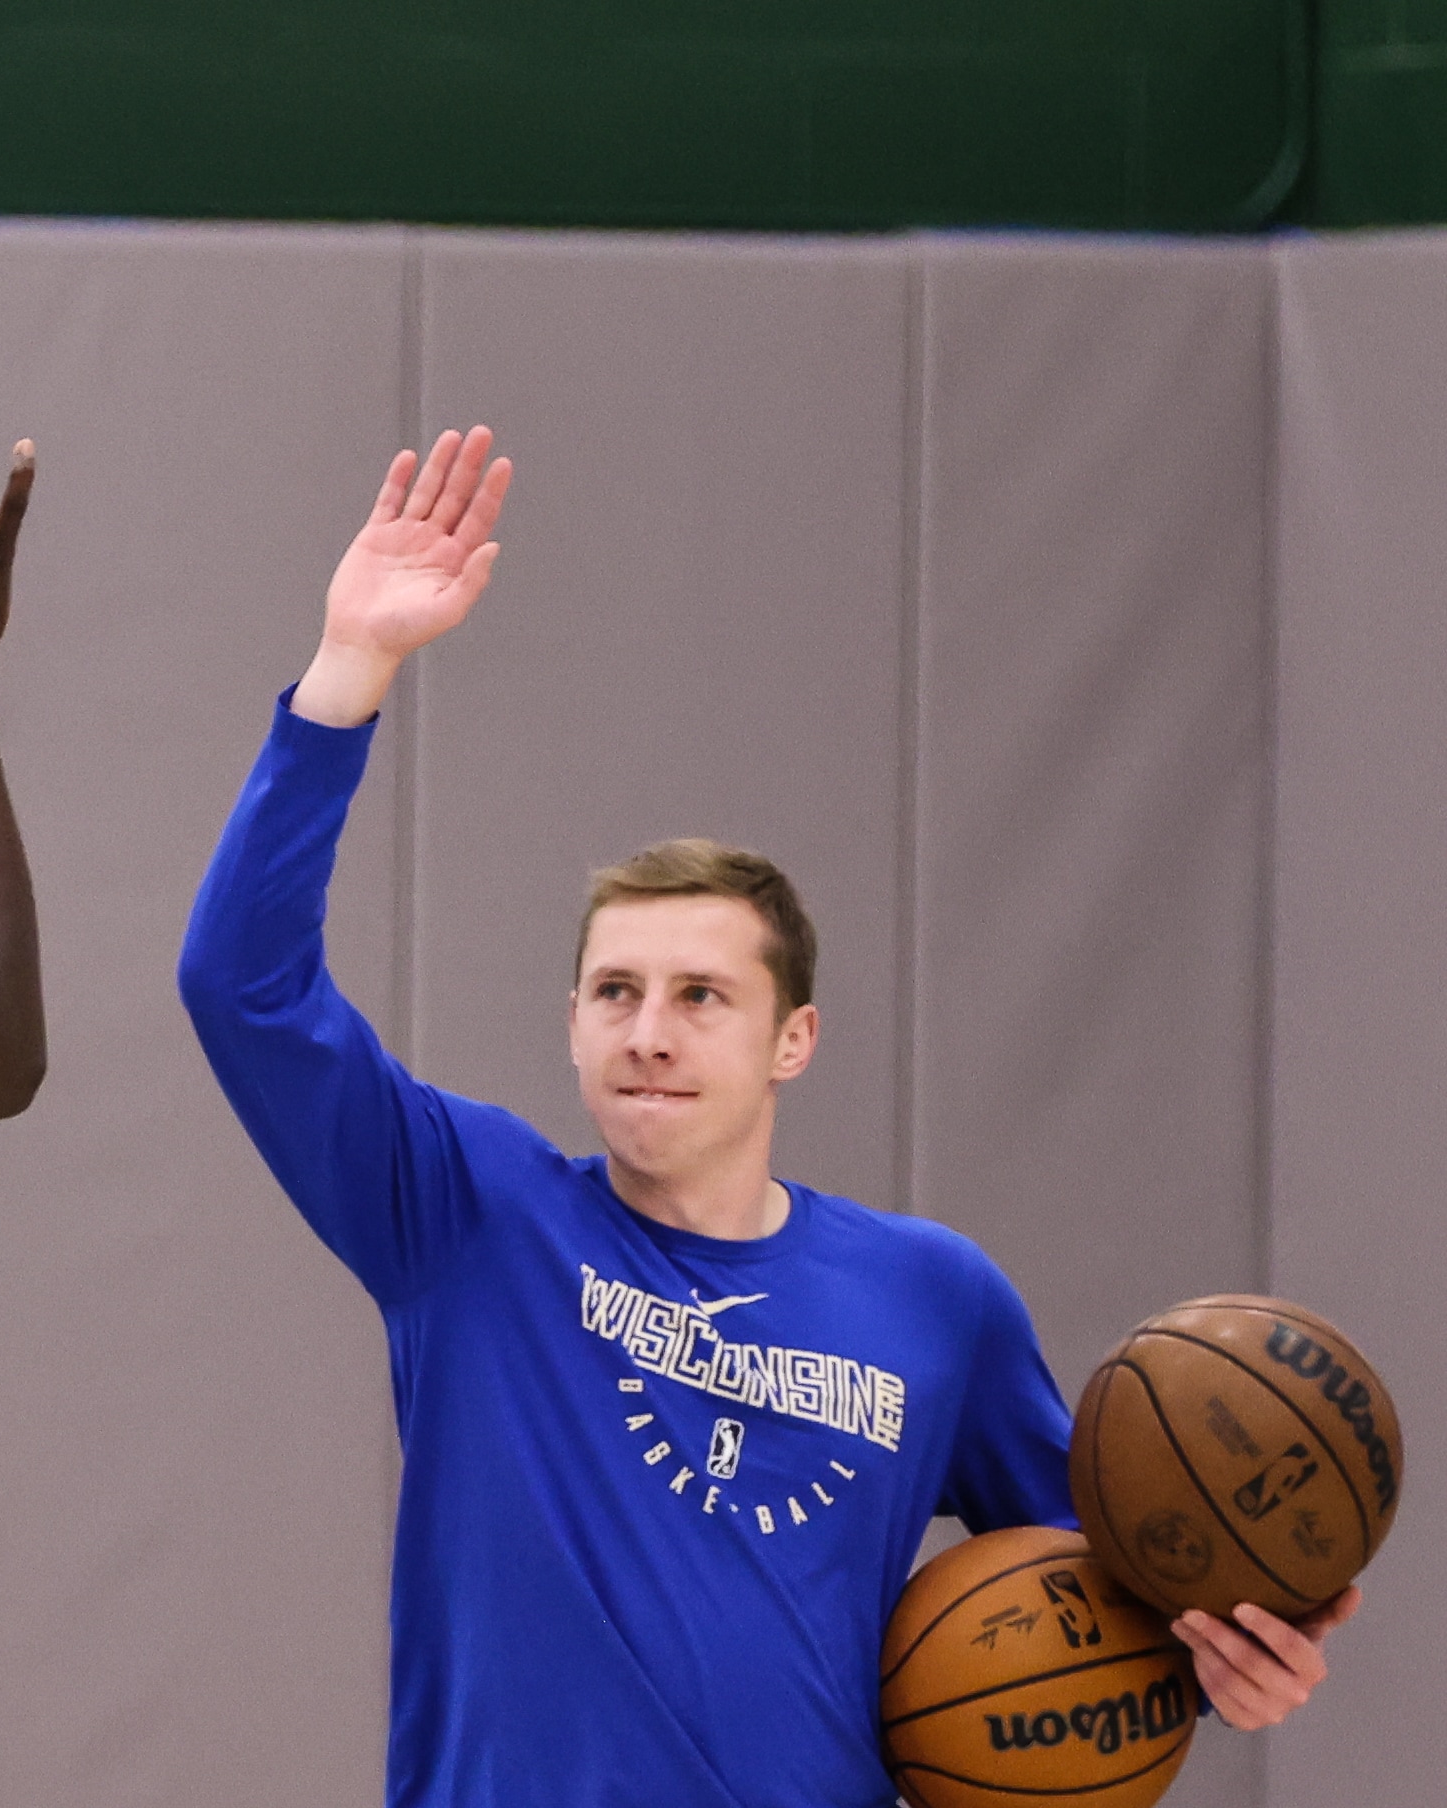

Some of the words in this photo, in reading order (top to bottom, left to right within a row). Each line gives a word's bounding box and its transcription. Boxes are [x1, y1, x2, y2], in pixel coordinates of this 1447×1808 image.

[580, 1263, 878, 1440] WISCONSIN
[875, 1367, 906, 1453] HERD
[618, 1378, 856, 1536] BASKEBALL
[984, 1673, 1188, 1755] Wilson
